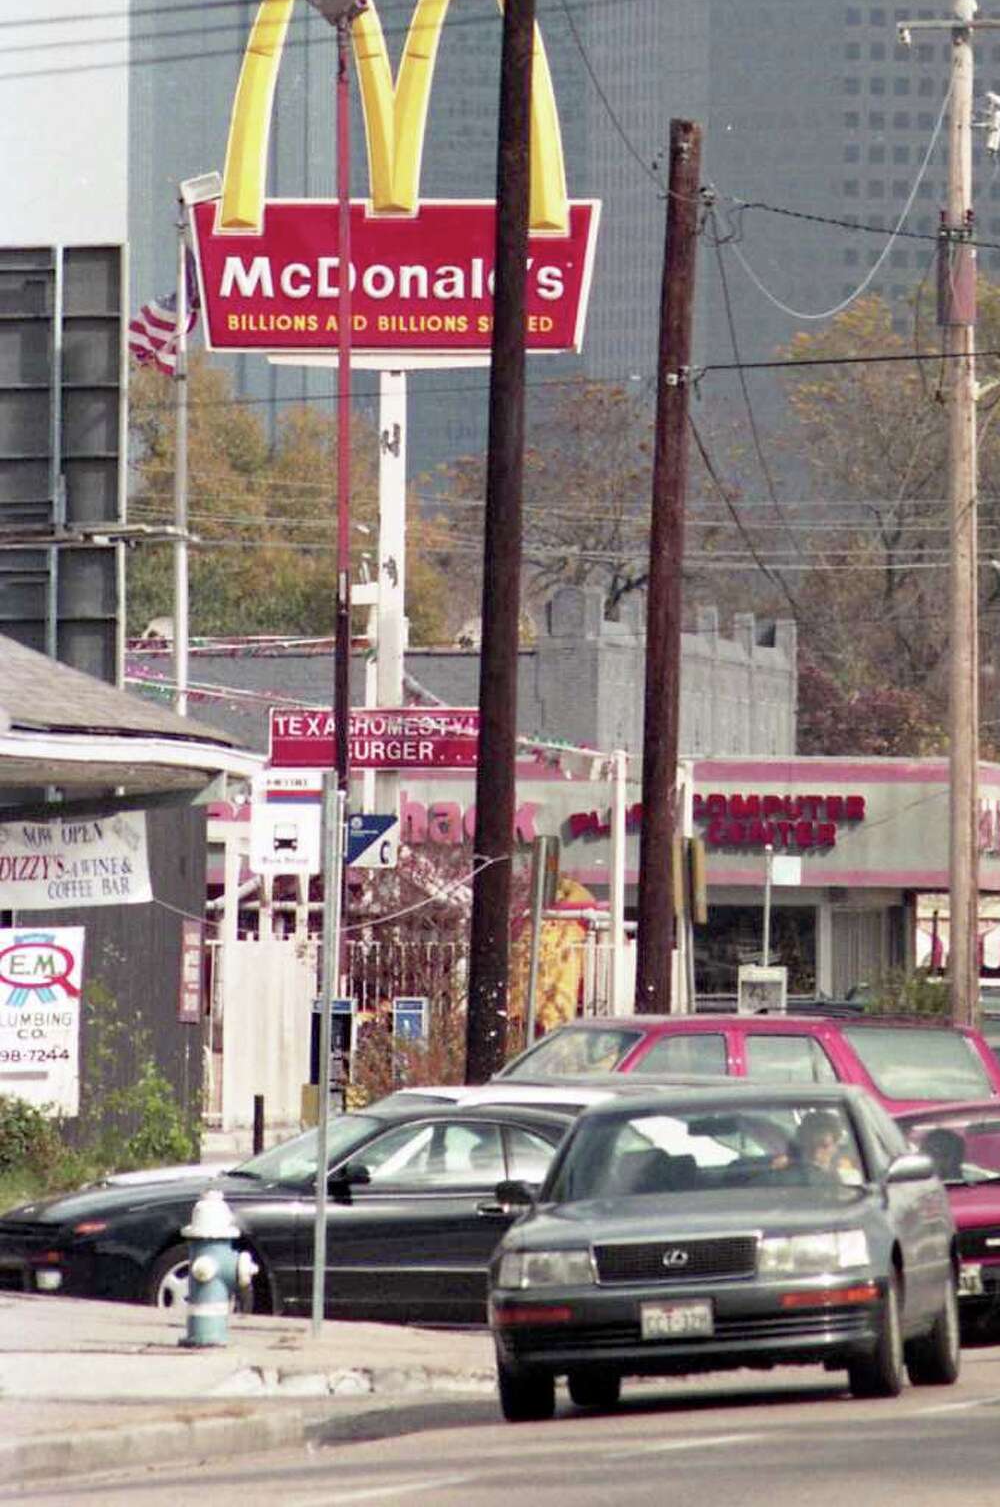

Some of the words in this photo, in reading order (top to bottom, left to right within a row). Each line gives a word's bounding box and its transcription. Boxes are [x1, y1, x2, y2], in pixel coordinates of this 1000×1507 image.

[219, 256, 565, 300] McDonal's
[228, 314, 318, 331] BILLIONS
[326, 315, 367, 331] AD
[377, 315, 469, 332] BILLIONS
[477, 316, 553, 332] SED
[0, 1012, 72, 1028] UMBING
